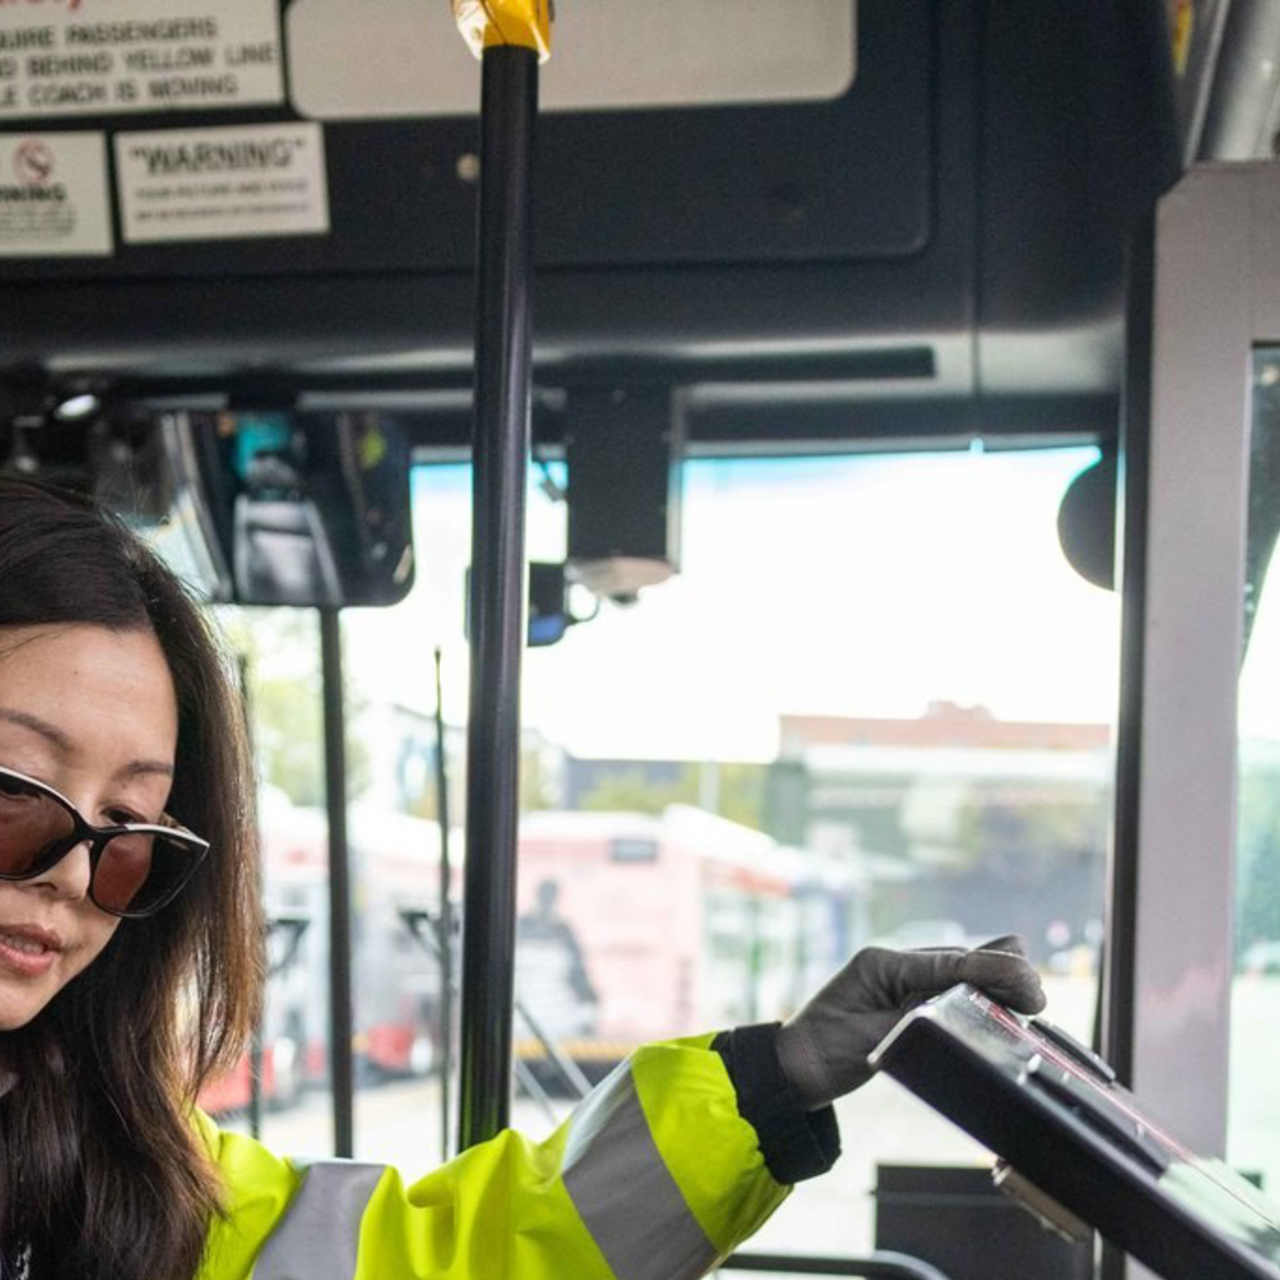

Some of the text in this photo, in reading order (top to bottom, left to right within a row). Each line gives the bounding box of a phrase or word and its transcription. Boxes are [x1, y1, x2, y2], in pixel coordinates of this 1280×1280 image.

[66, 16, 217, 46] PASSENGERS
[26, 53, 113, 77] BEHIND
[124, 46, 214, 71] YELLOW
[224, 42, 274, 66] LINE
[31, 82, 106, 106] COACH
[115, 79, 138, 101] IS
[148, 73, 238, 99] MOVING
